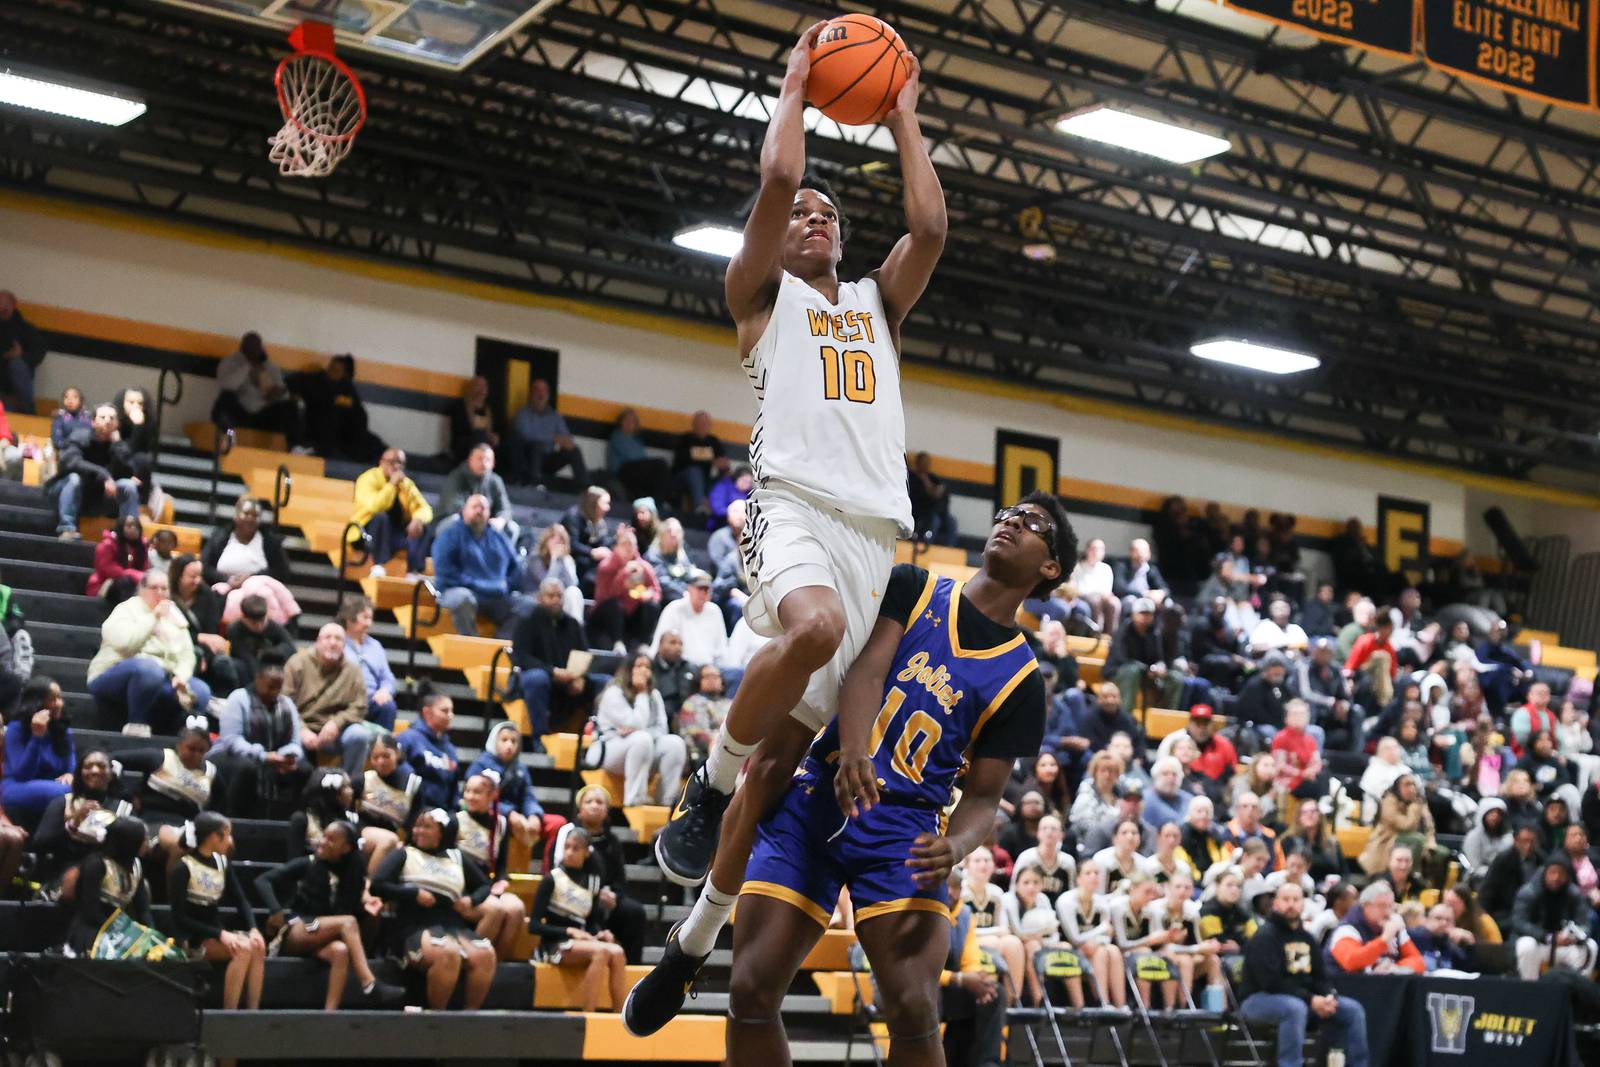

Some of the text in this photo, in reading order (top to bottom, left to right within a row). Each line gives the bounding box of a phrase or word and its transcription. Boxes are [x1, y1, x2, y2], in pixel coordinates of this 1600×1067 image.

[1292, 0, 1354, 30] 2022
[1453, 0, 1562, 59] ELITE EIGHT
[1477, 41, 1536, 85] 2022
[806, 308, 875, 344] WEST
[819, 345, 877, 405] 10
[896, 651, 964, 715] Joliet
[867, 685, 943, 785] 10
[1472, 1011, 1538, 1037] JOLIET
[1483, 1030, 1525, 1048] WEST
